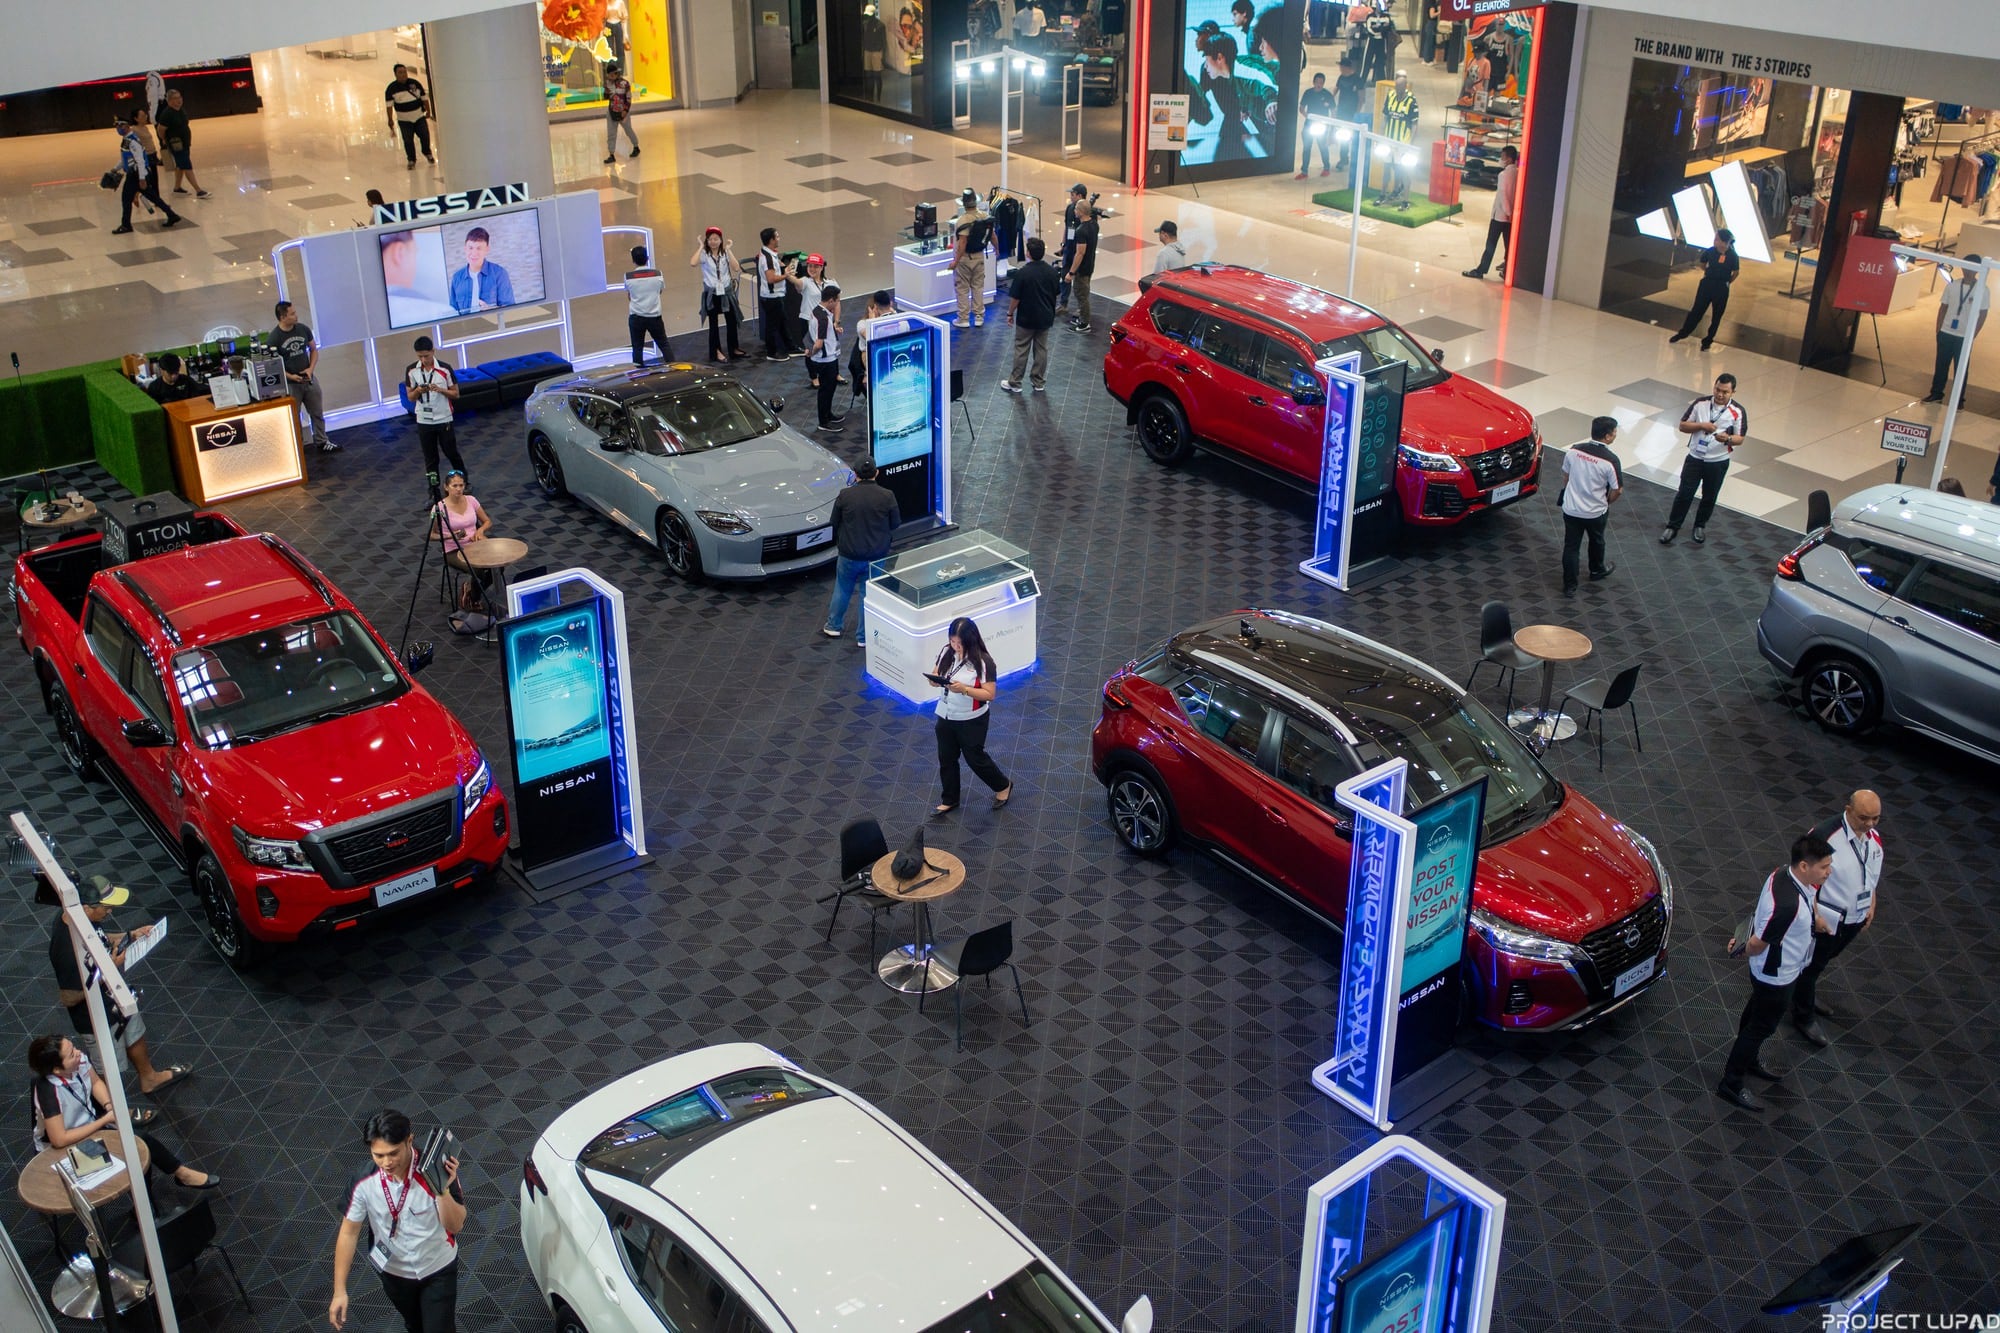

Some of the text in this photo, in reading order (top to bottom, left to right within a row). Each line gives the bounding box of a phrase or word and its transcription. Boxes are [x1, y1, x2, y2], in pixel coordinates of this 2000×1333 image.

[1474, 0, 1511, 12] ELEVATORS
[1634, 37, 1812, 79] THE BRAND WITH THE 3 STRIPES
[374, 181, 529, 225] NISSAN
[1858, 261, 1885, 275] SALE
[206, 429, 237, 441] NISSAN
[1888, 424, 1927, 437] CAUTION
[1894, 434, 1918, 444] WATCH
[1886, 441, 1923, 453] YOUR STEP
[886, 459, 922, 476] NISSAN
[1353, 499, 1383, 515] NISSAN
[109, 519, 125, 545] TON
[136, 520, 191, 545] 1 TON
[539, 640, 570, 654] NISSAN
[539, 771, 596, 798] NISSAN
[1426, 831, 1453, 848] NISSAN
[1416, 853, 1458, 886] POST
[382, 876, 429, 898] NAVARA
[1414, 875, 1455, 907] YOUR
[1406, 891, 1460, 930] NISSAN
[1621, 963, 1650, 985] KICKS
[1398, 976, 1445, 1011] NISSAN
[1379, 1276, 1416, 1307] NISSAN
